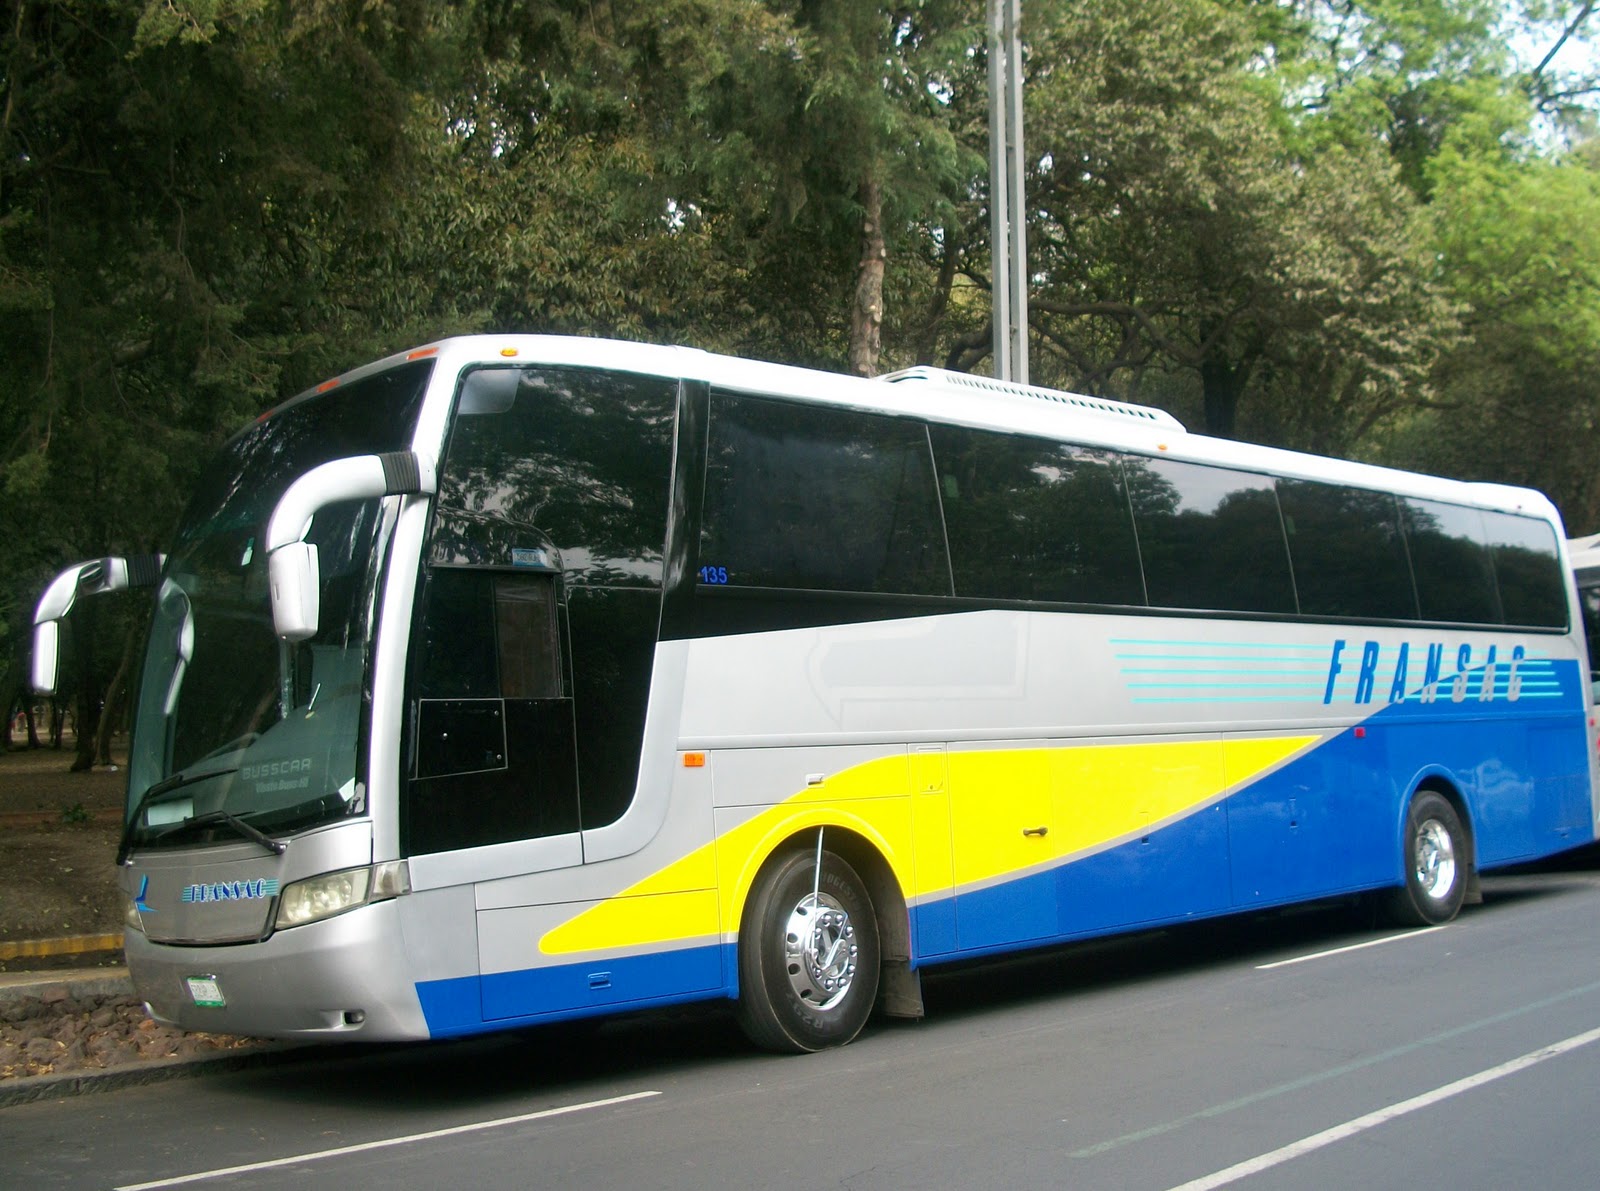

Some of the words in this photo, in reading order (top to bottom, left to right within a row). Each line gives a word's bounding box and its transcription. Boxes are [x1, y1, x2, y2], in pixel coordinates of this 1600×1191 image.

[701, 565, 728, 584] 135
[1323, 639, 1526, 704] FRANSAC
[242, 758, 312, 780] BUSSCAR
